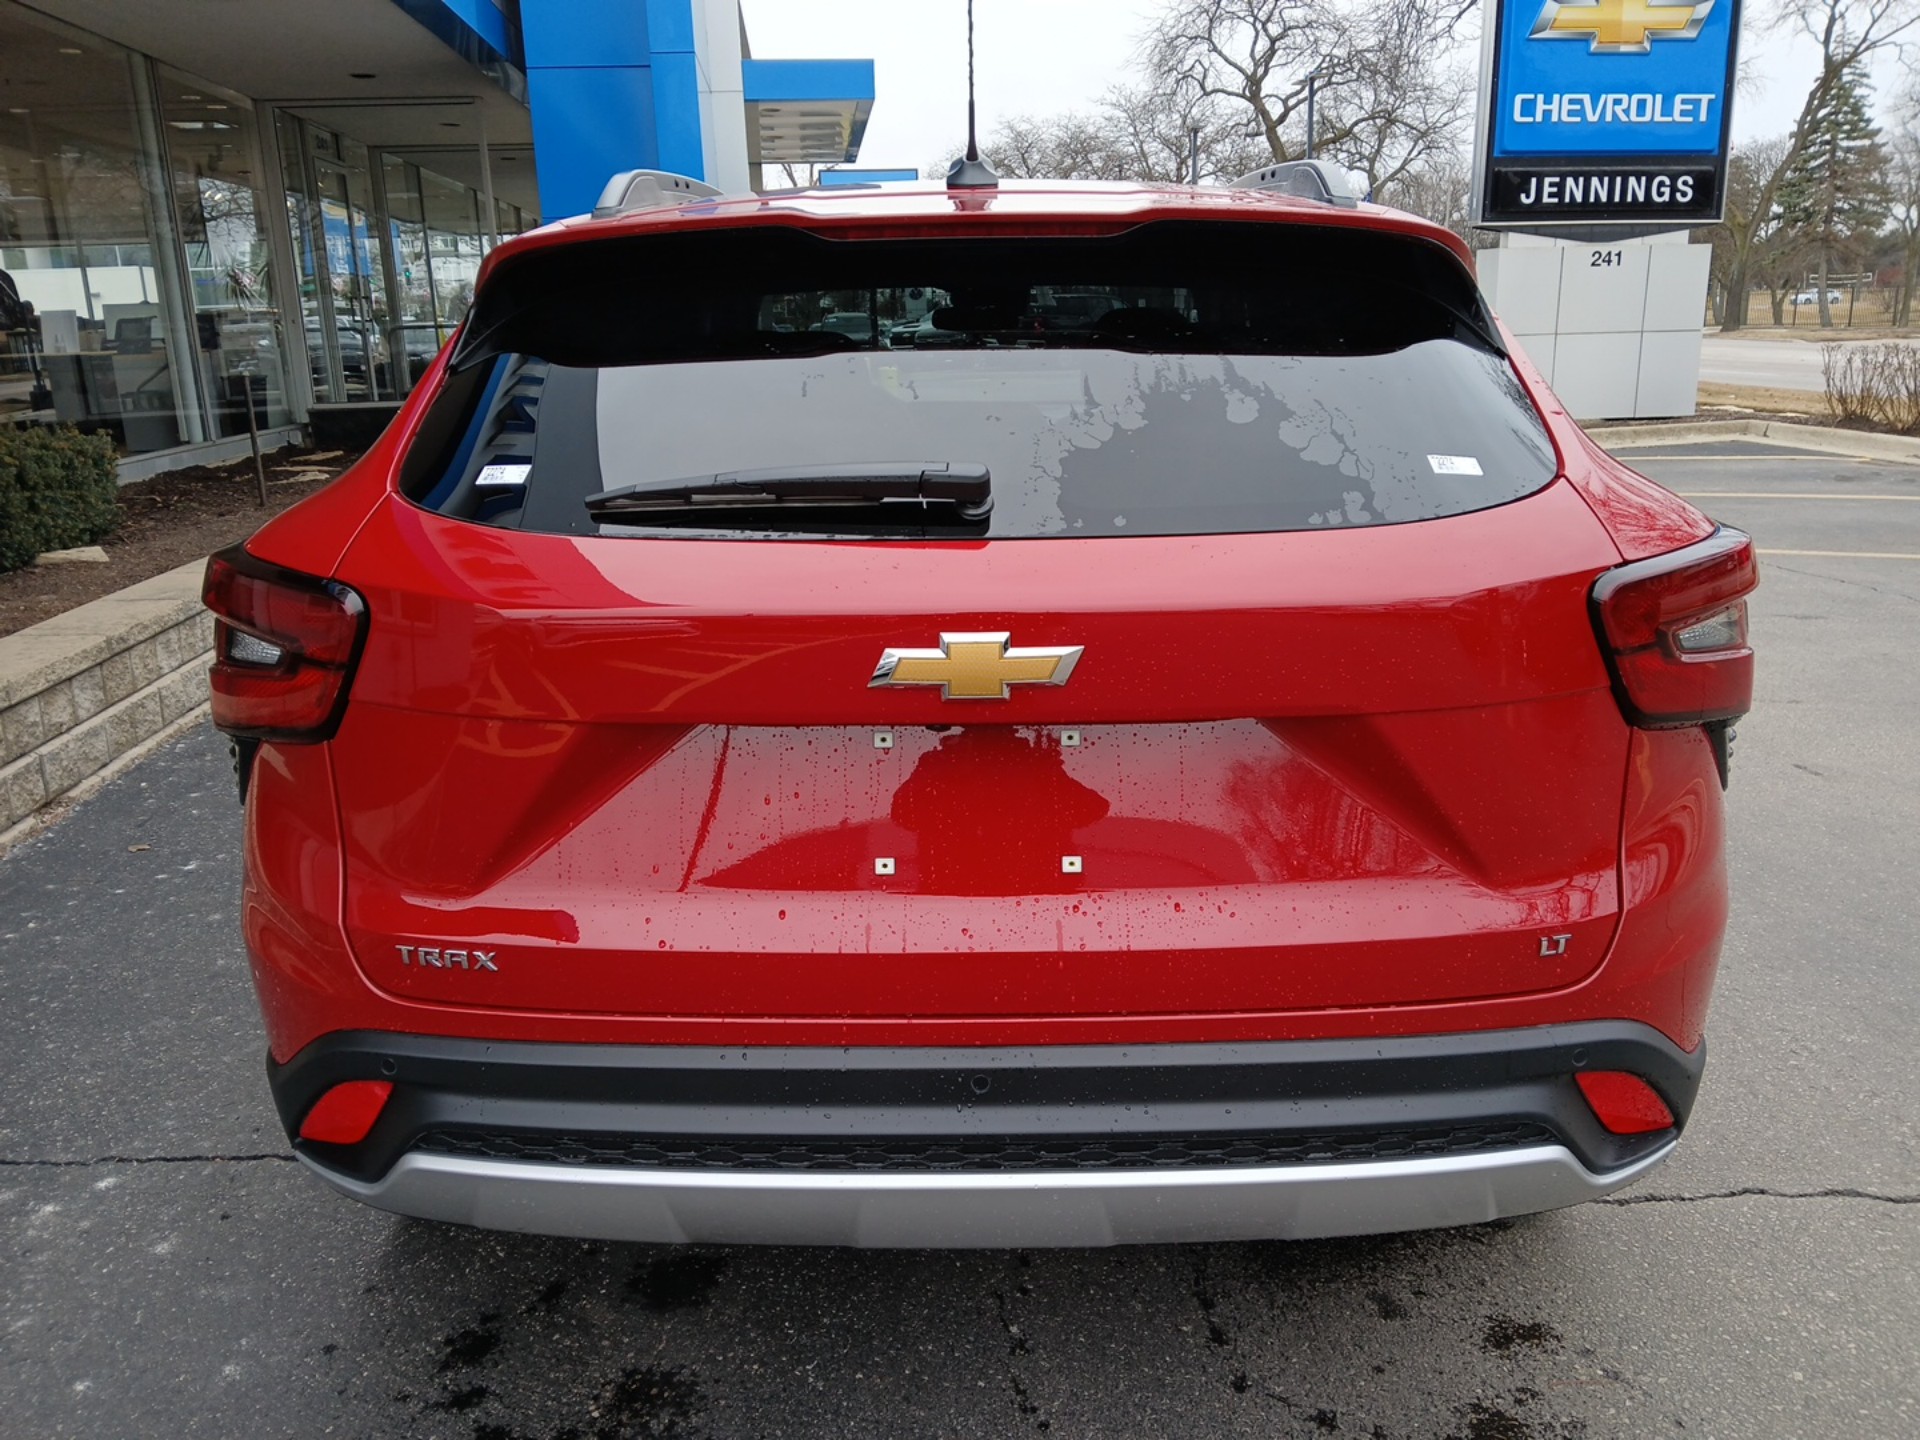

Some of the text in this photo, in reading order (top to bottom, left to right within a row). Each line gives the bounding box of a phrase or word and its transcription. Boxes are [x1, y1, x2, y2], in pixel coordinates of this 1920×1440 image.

[1513, 93, 1716, 123] CHEVROLET
[1520, 175, 1694, 205] JENNINGS
[1590, 250, 1622, 267] 241
[395, 944, 499, 972] TRAX
[1539, 933, 1573, 957] LT
